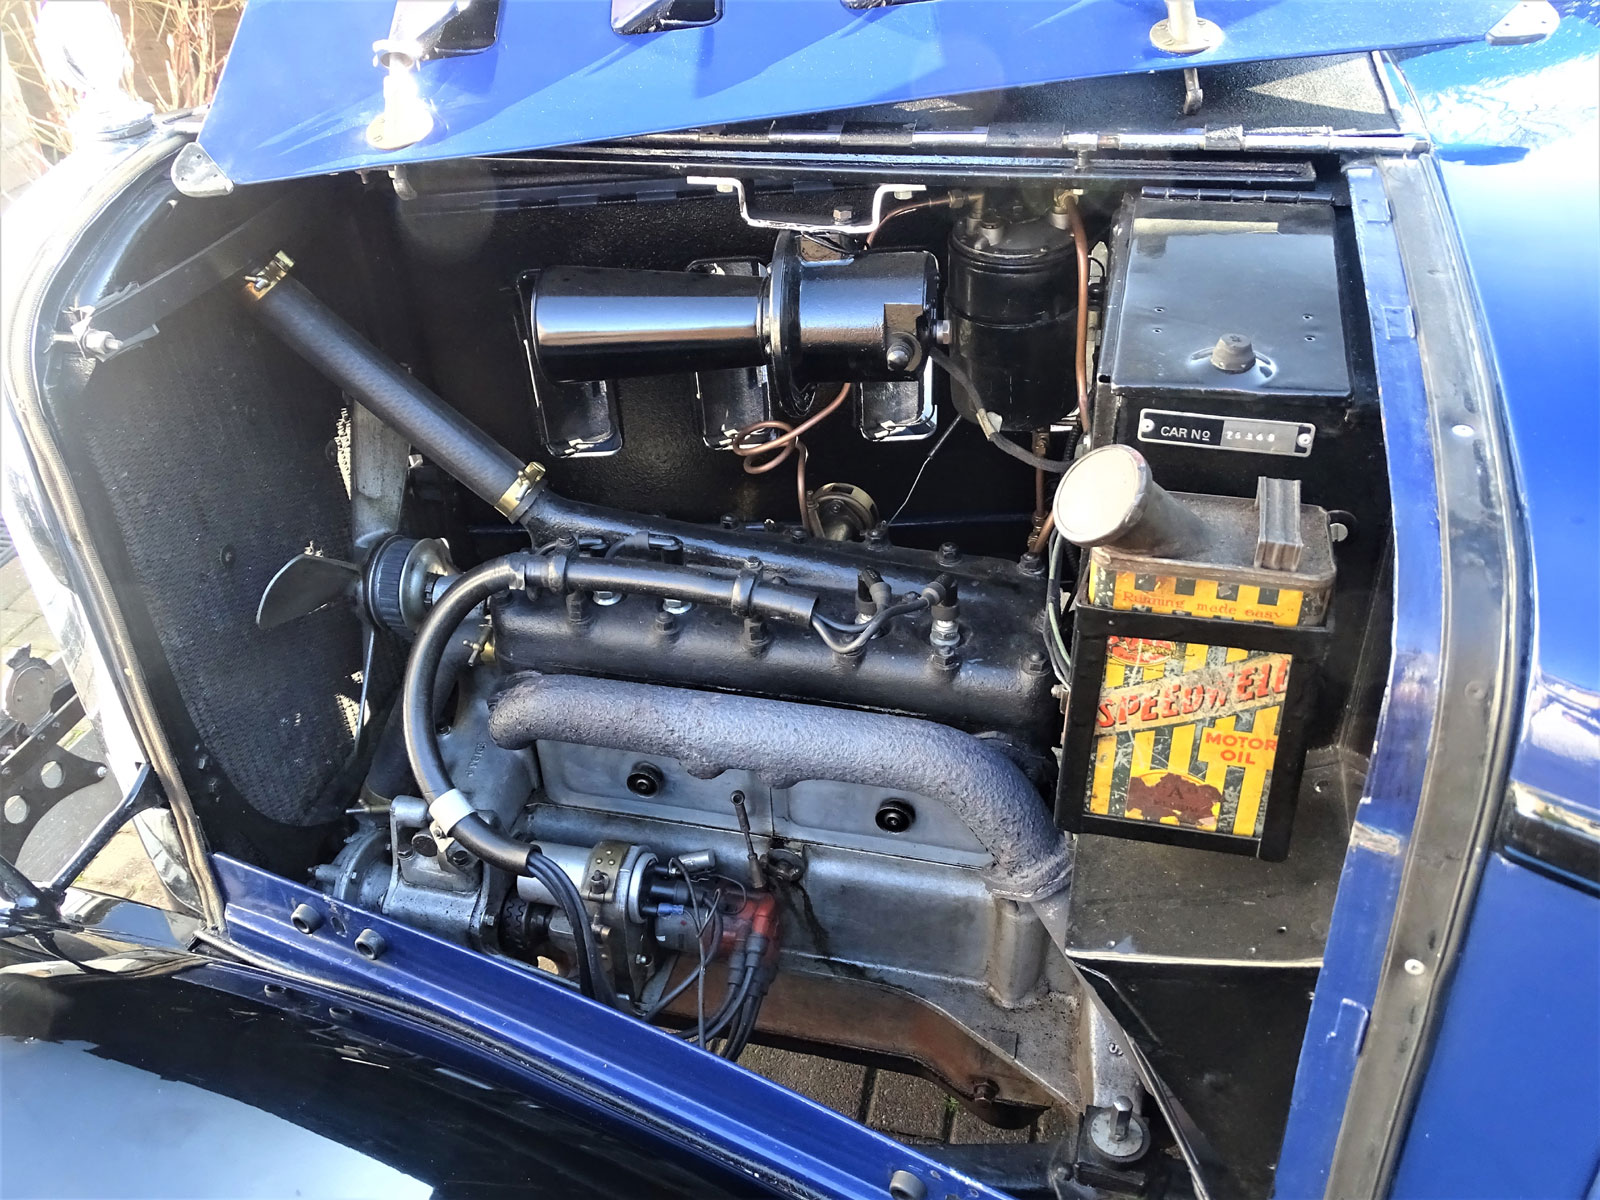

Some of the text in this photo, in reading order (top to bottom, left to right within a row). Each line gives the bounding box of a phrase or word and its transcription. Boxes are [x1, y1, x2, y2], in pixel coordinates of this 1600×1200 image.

[1160, 425, 1188, 439] CAR
[1197, 602, 1237, 615] made
[1205, 731, 1277, 752] MOTOR
[1220, 749, 1256, 765] OIL
